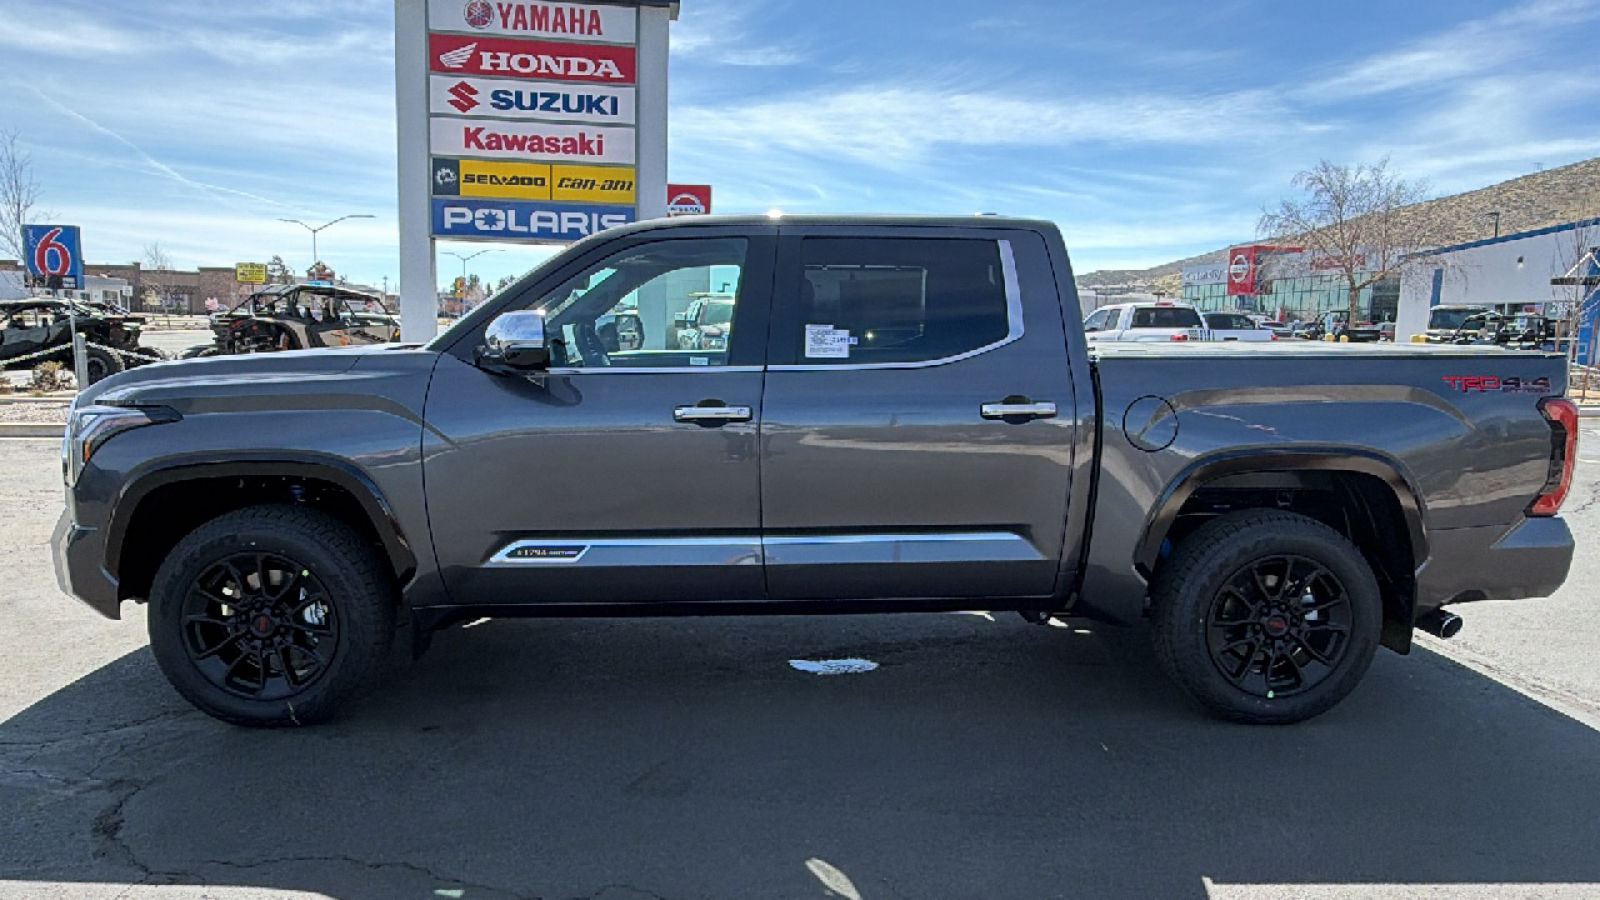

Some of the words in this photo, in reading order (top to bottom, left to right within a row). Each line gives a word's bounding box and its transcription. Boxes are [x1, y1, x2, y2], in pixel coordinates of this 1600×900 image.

[497, 2, 603, 36] YAMAHA
[479, 51, 625, 78] HONDA
[490, 89, 618, 115] SUZUKI
[464, 126, 603, 155] Kawasaki
[35, 227, 71, 275] 6
[1441, 375, 1501, 392] TRD
